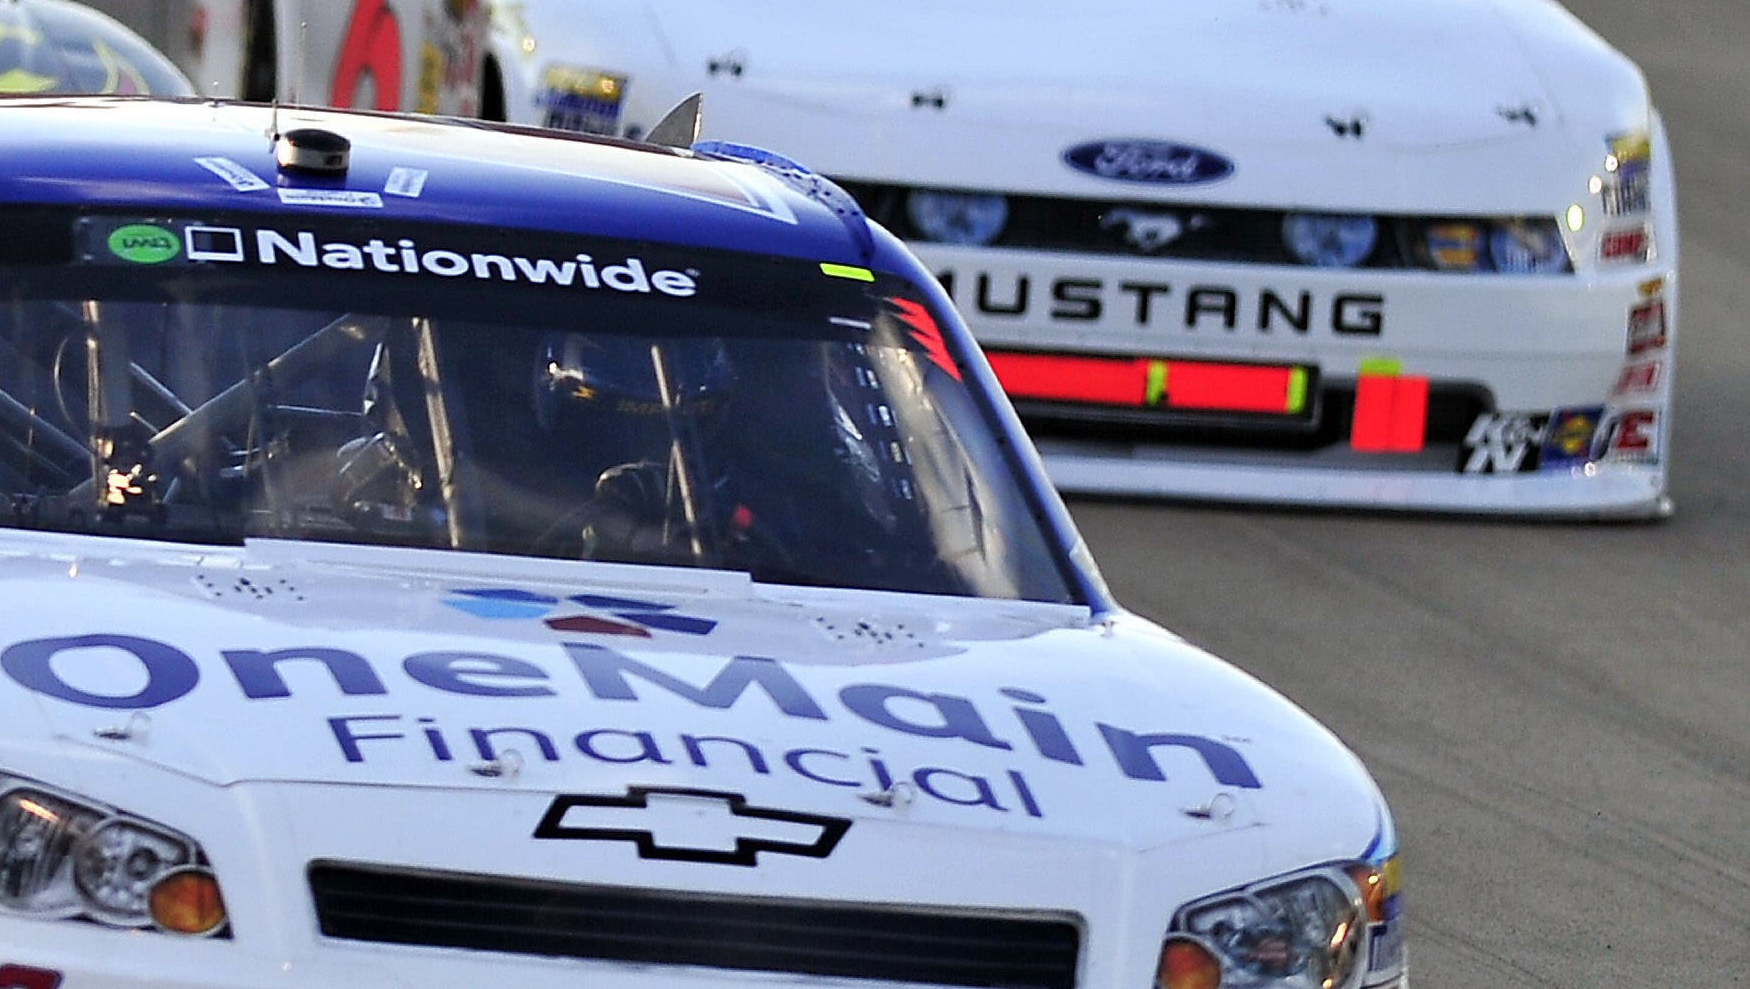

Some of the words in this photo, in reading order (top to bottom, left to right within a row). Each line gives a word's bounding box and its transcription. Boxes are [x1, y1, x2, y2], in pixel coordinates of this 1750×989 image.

[1092, 140, 1199, 180] Ford
[256, 228, 697, 298] Nationwide
[0, 633, 1261, 789] OneMain
[327, 714, 1043, 818] Financial
